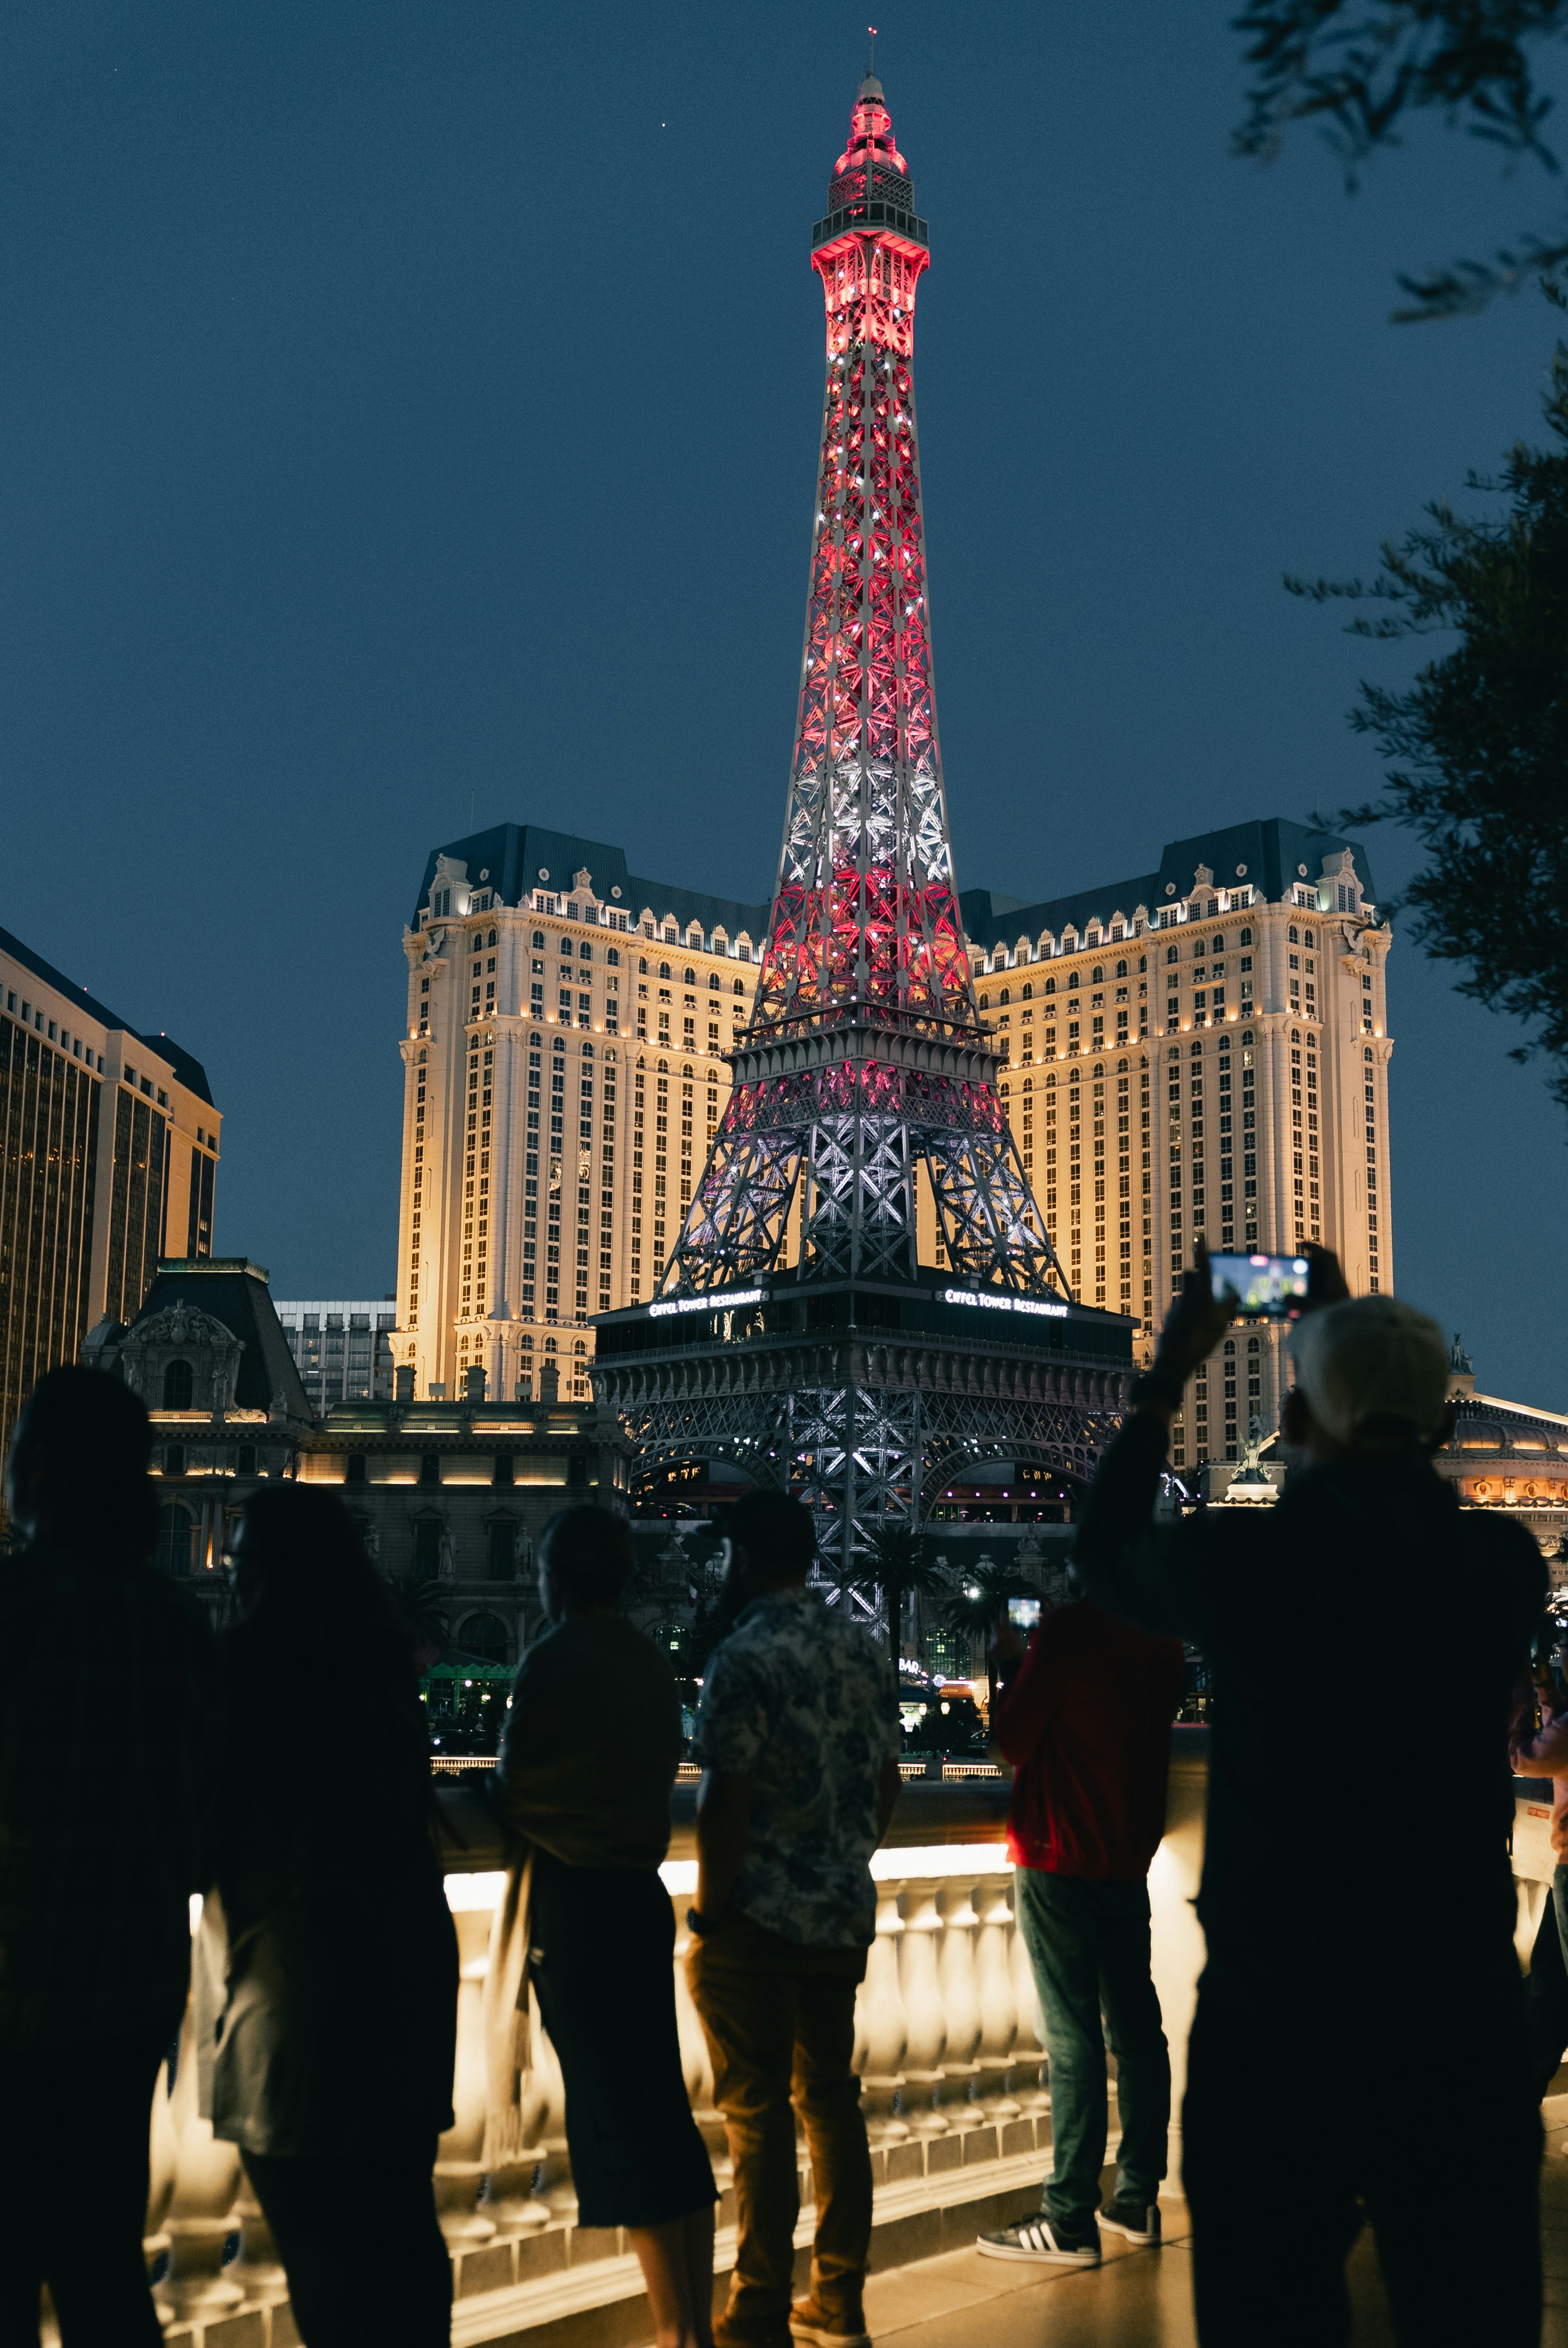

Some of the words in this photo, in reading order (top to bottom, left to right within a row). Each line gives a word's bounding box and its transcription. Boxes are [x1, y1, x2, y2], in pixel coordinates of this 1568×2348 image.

[650, 1303, 678, 1317] EIFFEL
[678, 1298, 708, 1312] TOWER
[710, 1289, 762, 1307] RESTAURANT
[945, 1289, 977, 1306] EIFFEL
[978, 1293, 1011, 1310] TOWER
[1014, 1298, 1068, 1317] RESTAURANT
[899, 1658, 918, 1674] BAR
